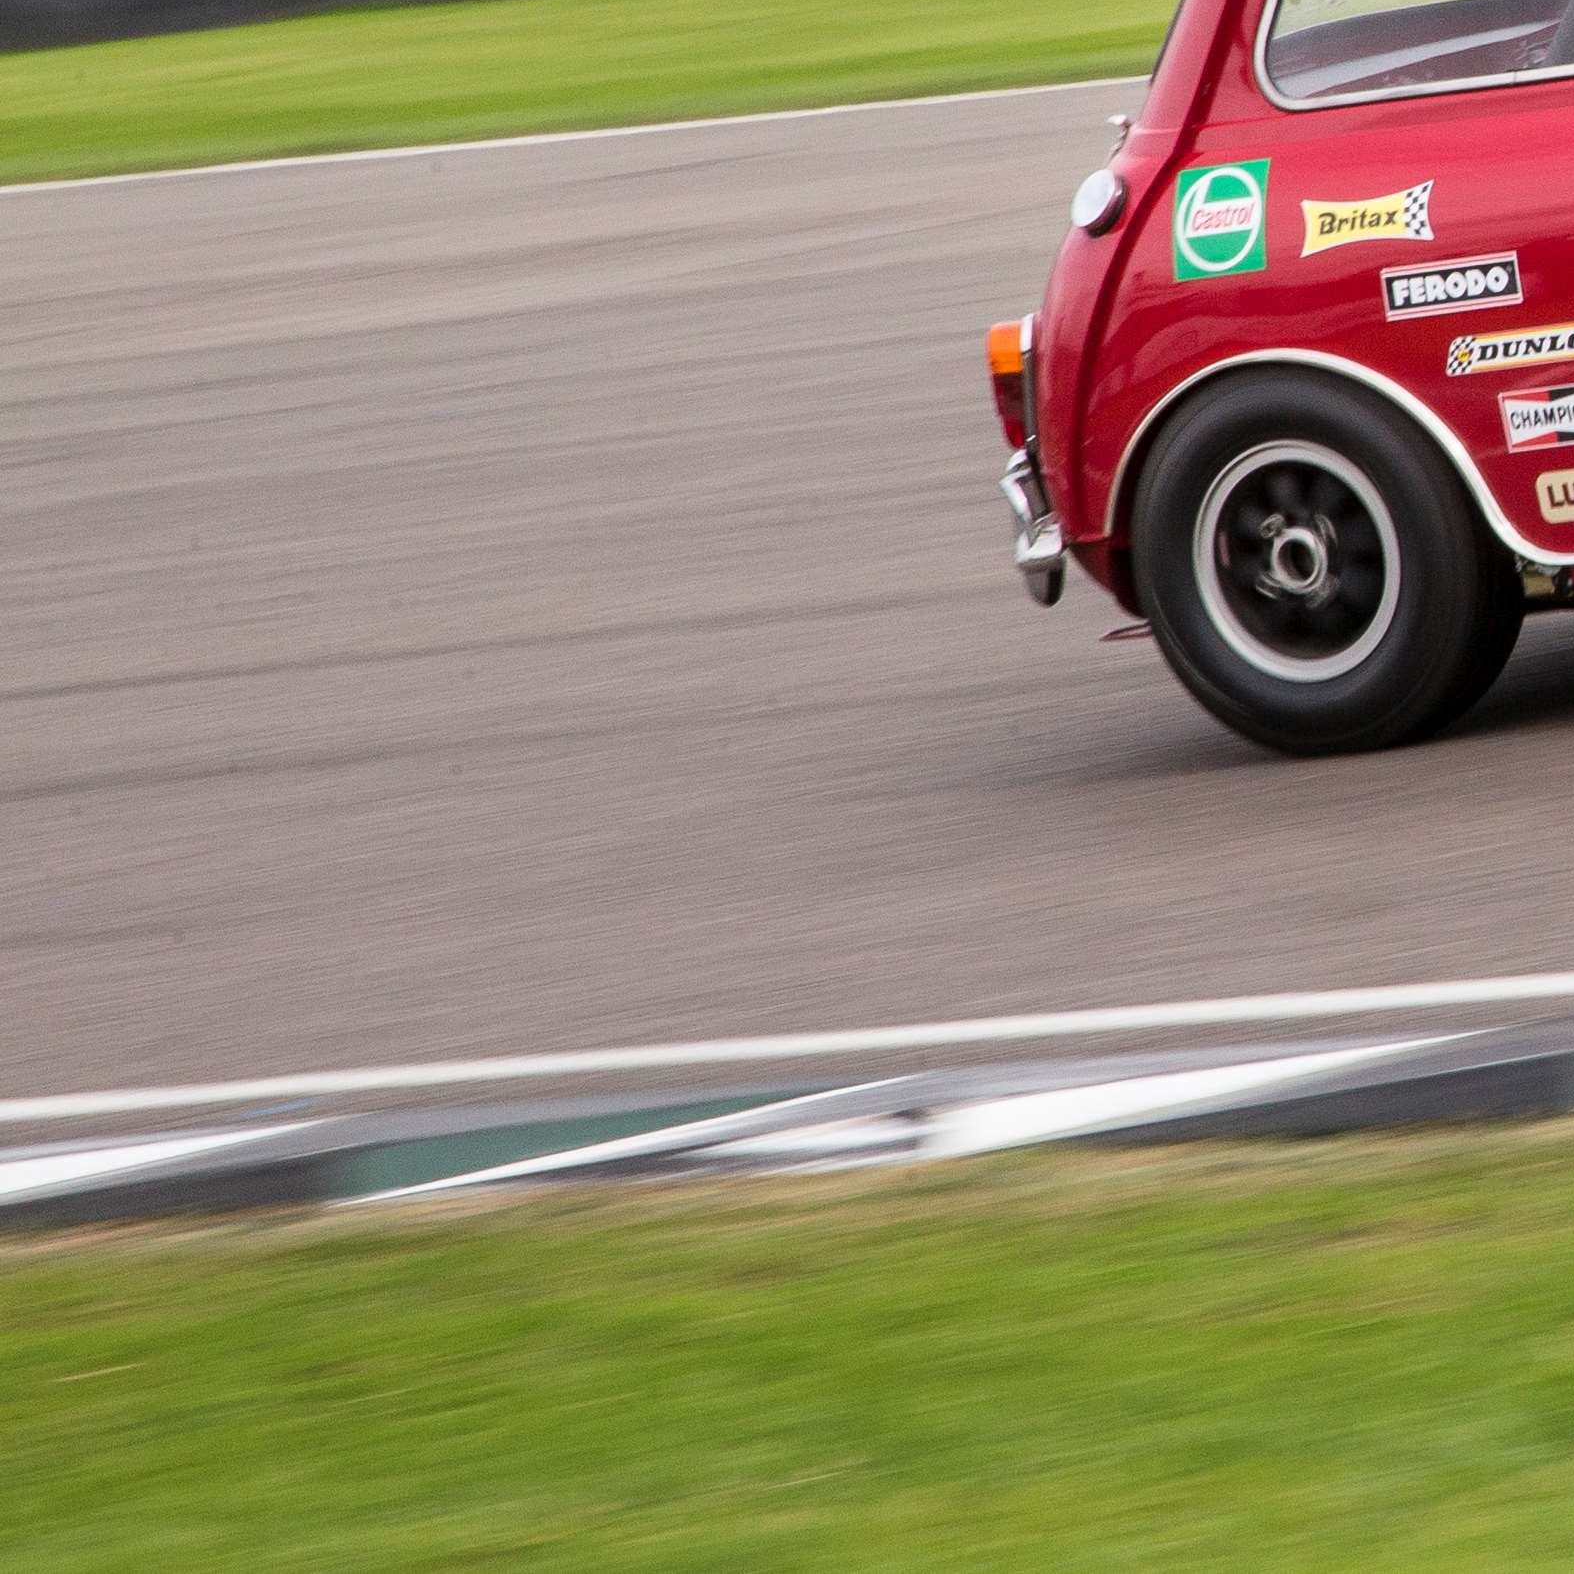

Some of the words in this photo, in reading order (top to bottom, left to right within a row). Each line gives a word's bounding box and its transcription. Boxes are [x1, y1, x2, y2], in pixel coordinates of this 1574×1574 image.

[1191, 203, 1255, 231] Castrol
[1318, 209, 1399, 237] Britax
[1392, 265, 1509, 307] FERODO
